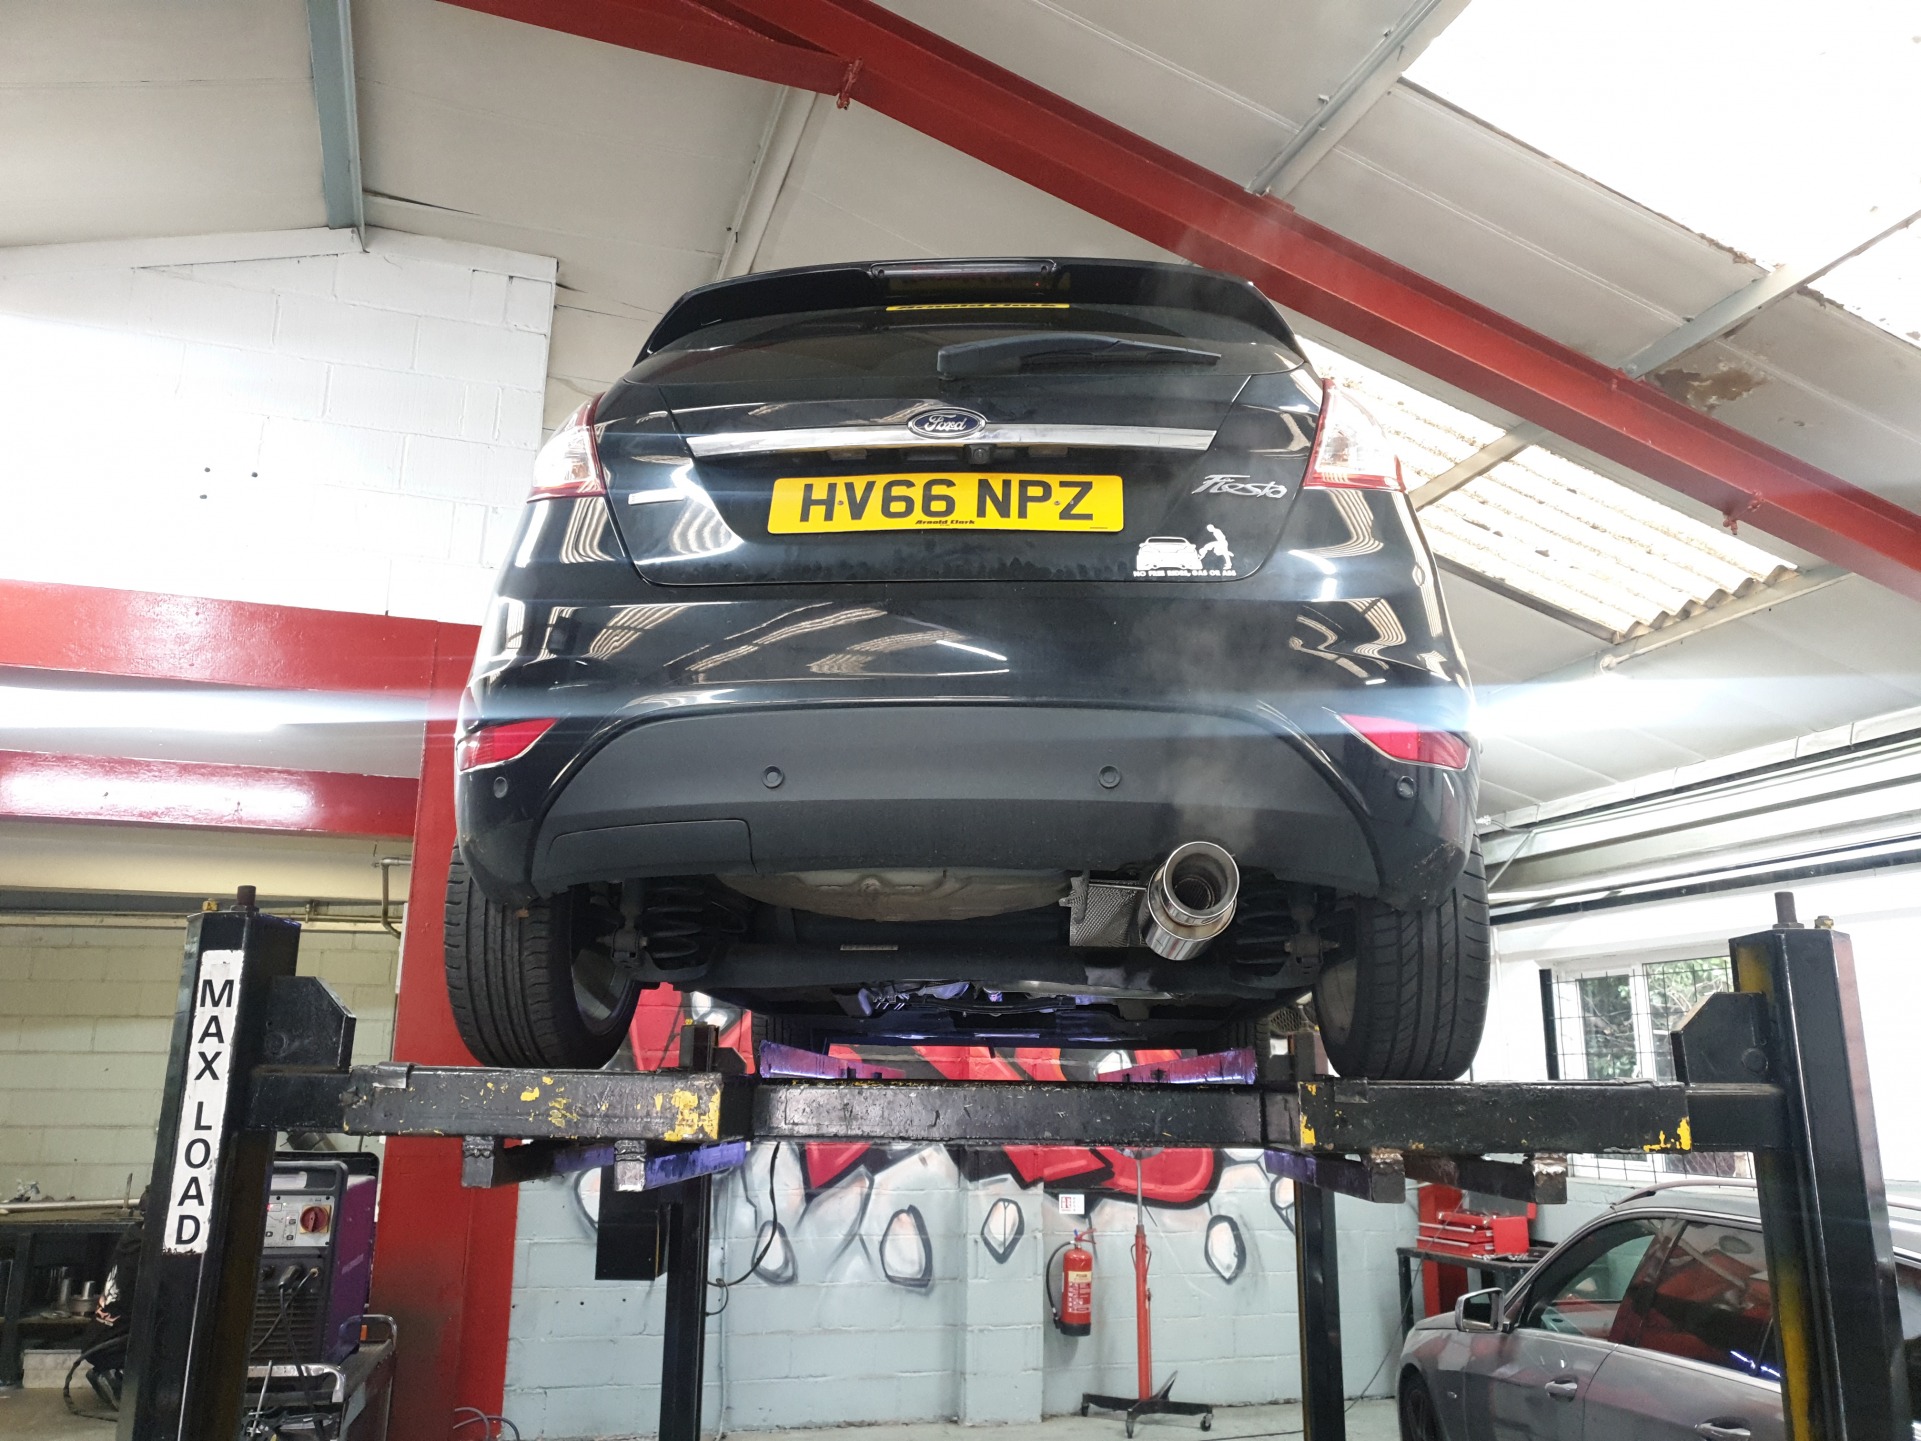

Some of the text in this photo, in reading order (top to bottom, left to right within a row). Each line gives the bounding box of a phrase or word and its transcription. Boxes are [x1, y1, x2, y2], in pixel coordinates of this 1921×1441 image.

[924, 414, 968, 432] Ford
[799, 478, 1094, 523] HV66 NPZ
[1191, 474, 1288, 499] Fiesta
[174, 978, 235, 1246] MAX LOAD
